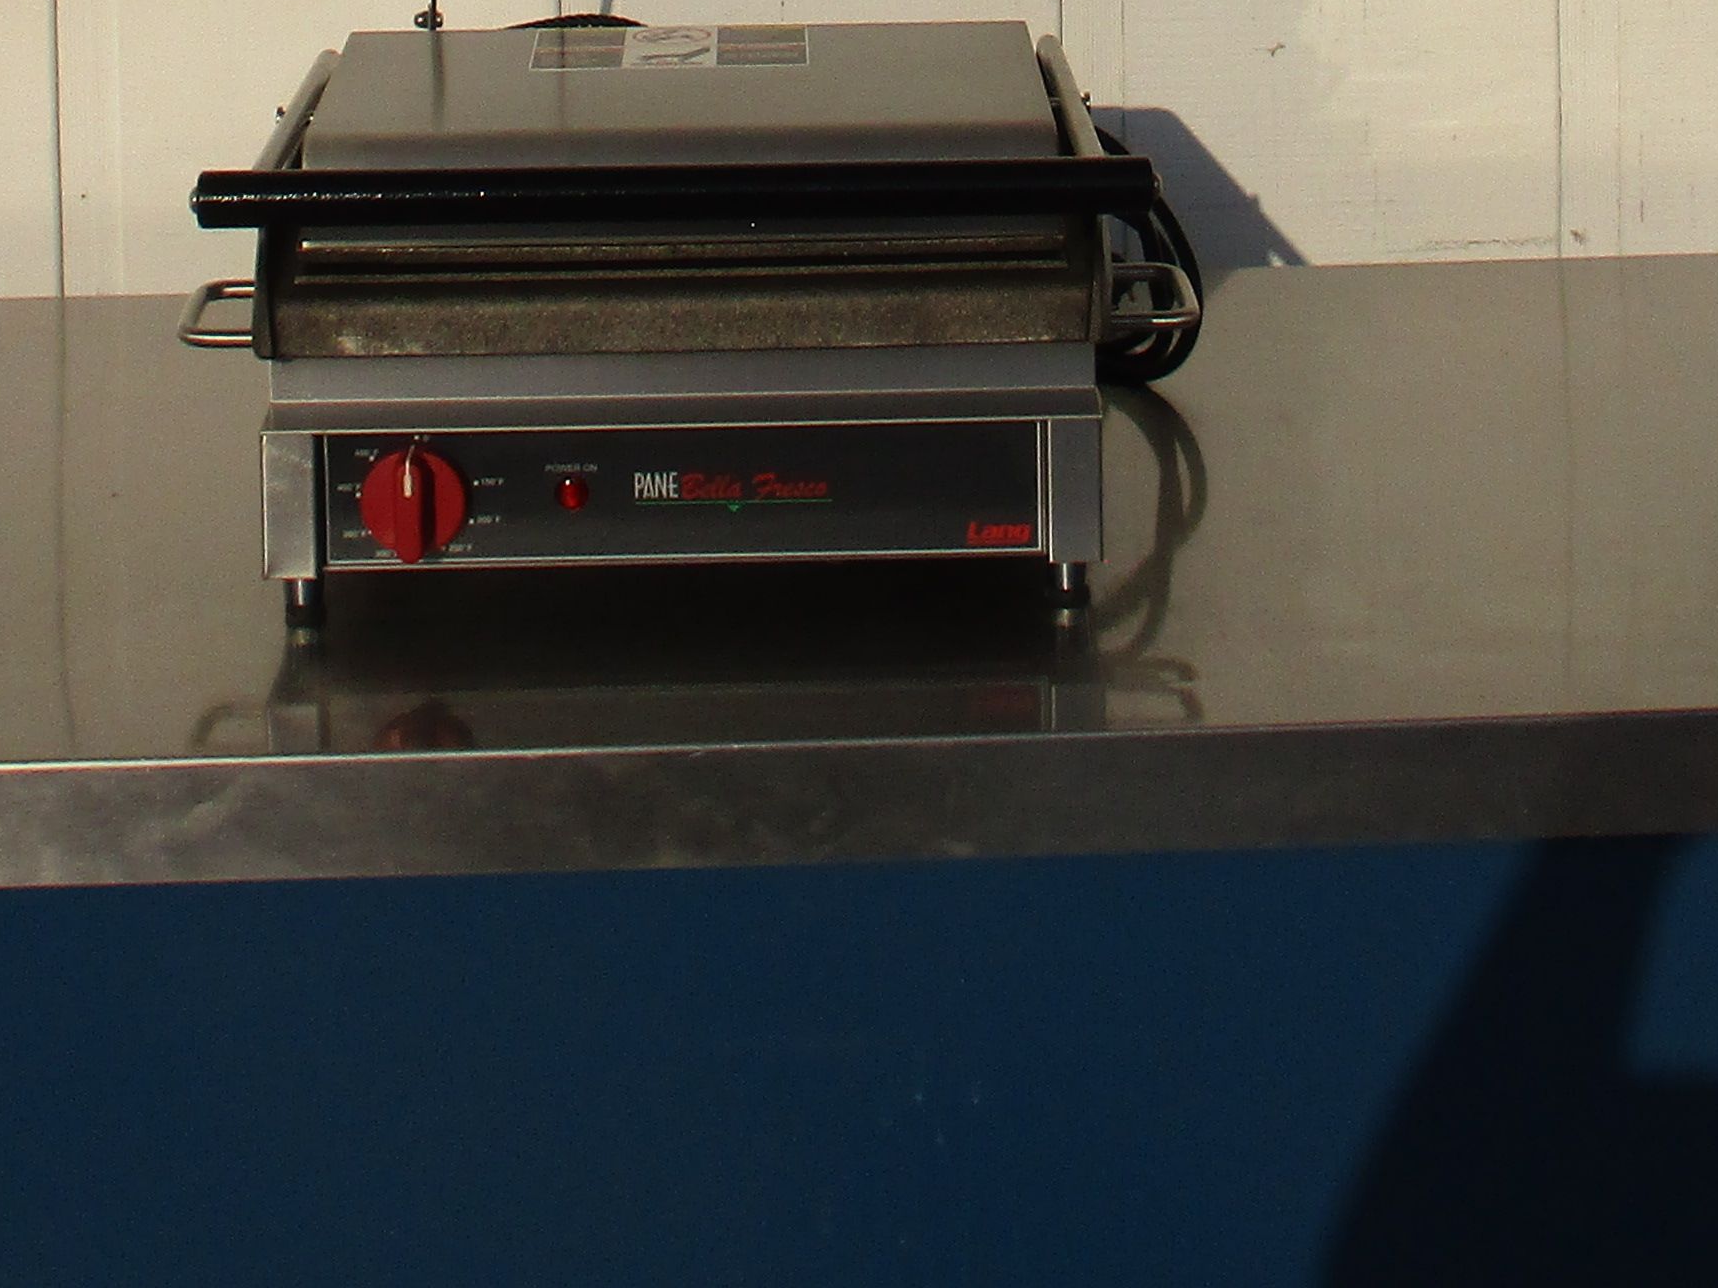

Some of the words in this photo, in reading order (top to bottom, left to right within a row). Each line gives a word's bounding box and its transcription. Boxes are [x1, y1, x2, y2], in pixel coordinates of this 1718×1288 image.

[545, 464, 581, 473] POWER
[583, 463, 598, 472] ON
[634, 472, 679, 499] PANE
[682, 473, 742, 500] Bella
[967, 522, 1032, 545] Lang
